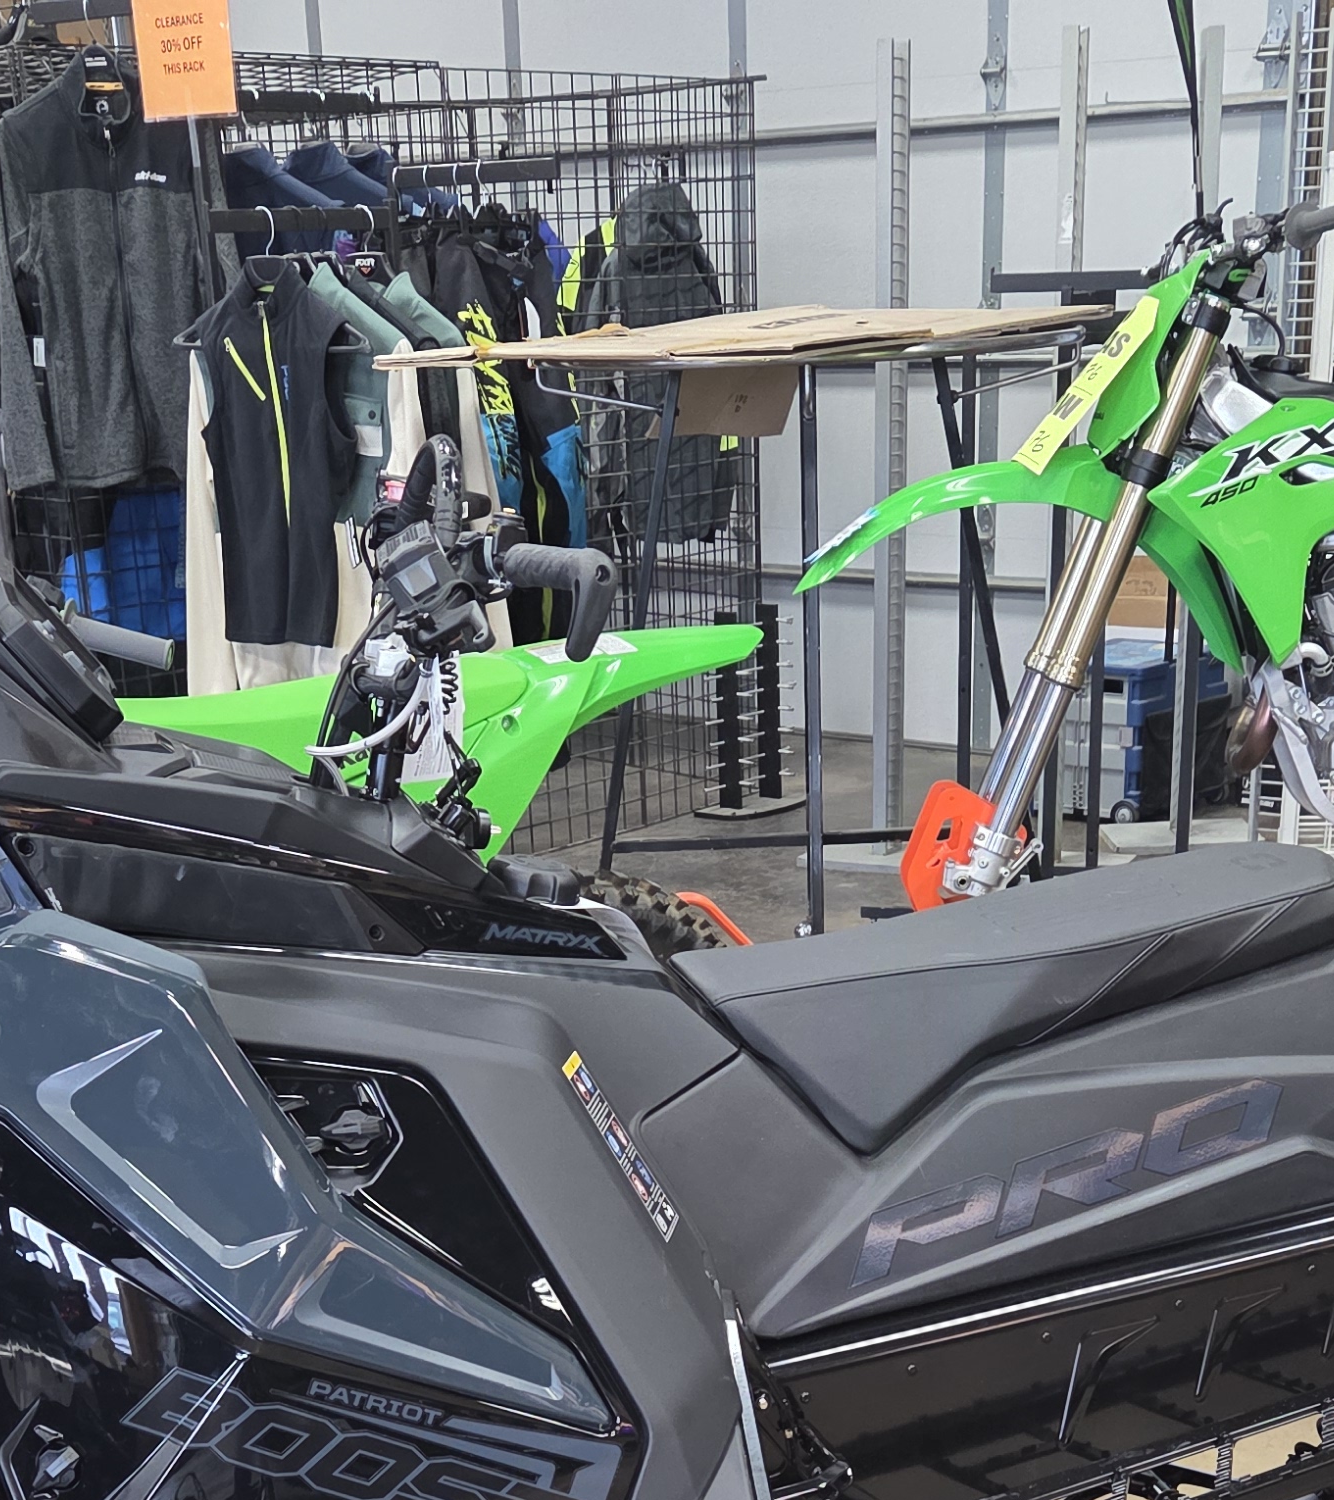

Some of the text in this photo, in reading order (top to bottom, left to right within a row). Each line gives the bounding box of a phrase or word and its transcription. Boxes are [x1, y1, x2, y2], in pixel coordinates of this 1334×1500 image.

[154, 13, 204, 29] CLEARANCE
[160, 35, 203, 54] 30% OFF
[163, 60, 205, 76] THIS RACK
[1200, 476, 1259, 508] 450
[484, 922, 605, 955] MATRYX
[849, 1077, 1285, 1291] PRO
[308, 1379, 444, 1428] PATRIOT
